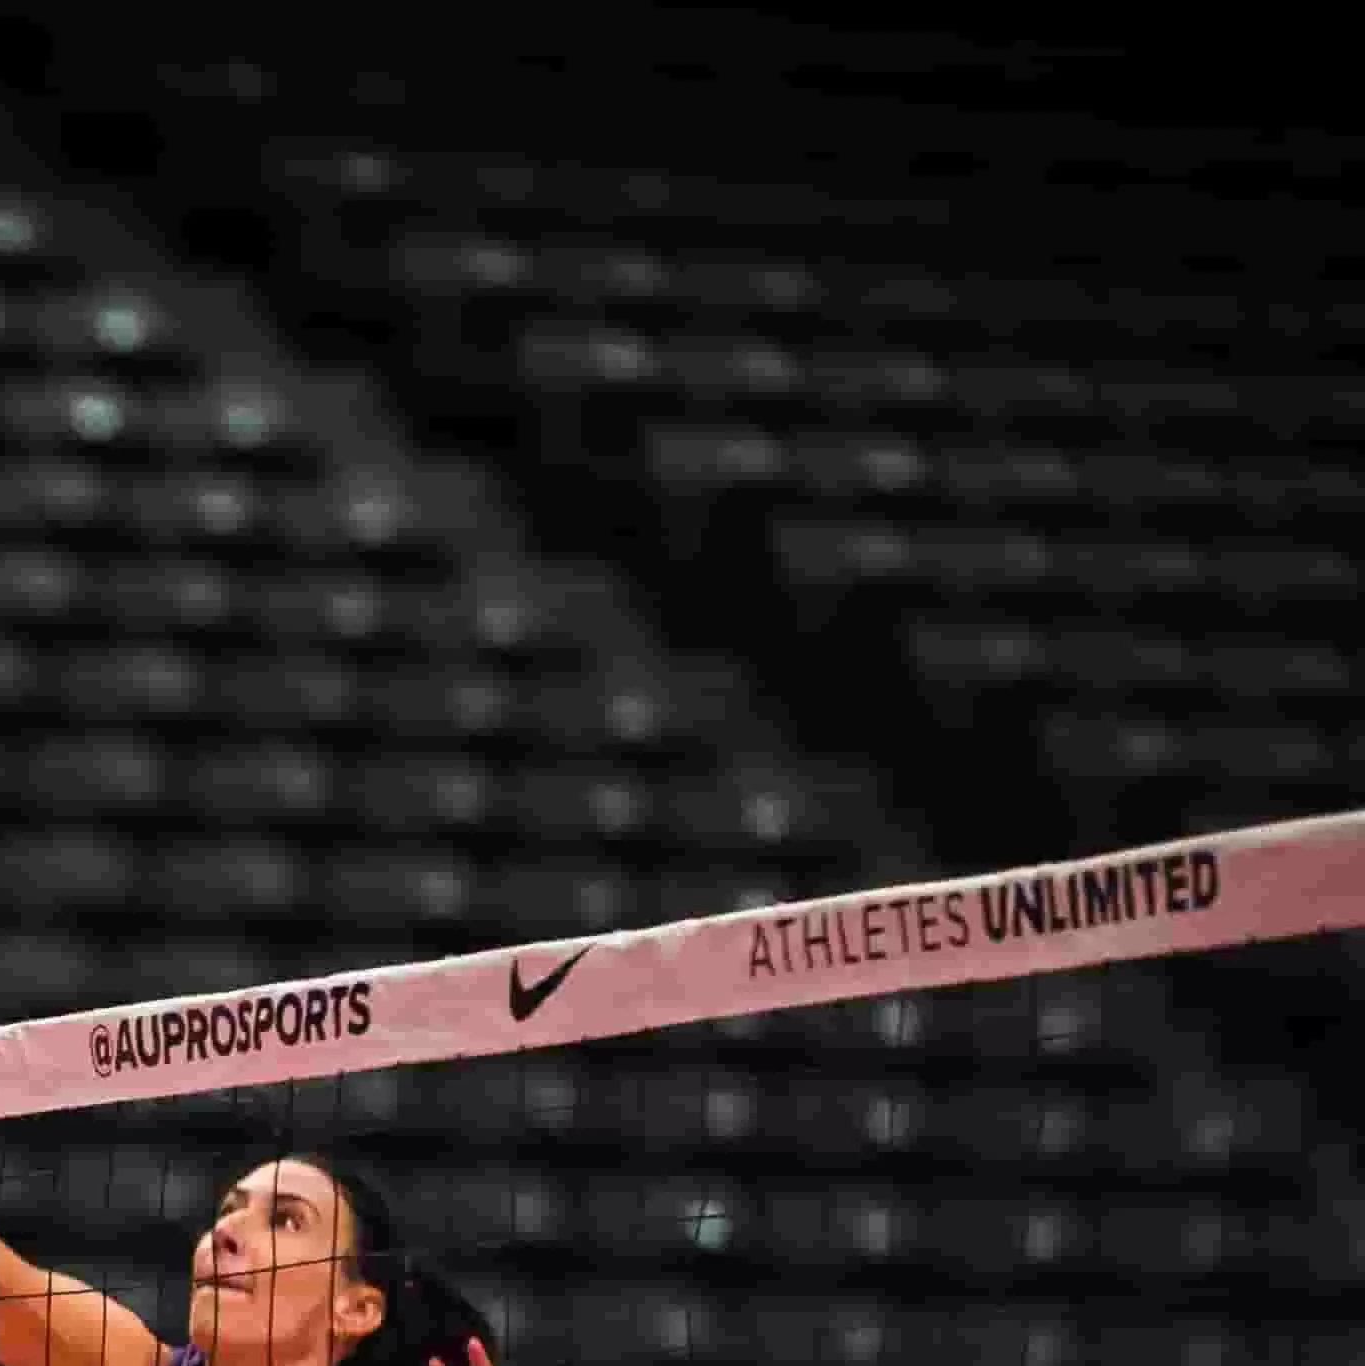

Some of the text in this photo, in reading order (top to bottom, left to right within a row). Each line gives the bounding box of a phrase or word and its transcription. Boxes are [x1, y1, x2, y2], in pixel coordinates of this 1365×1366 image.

[749, 851, 1219, 978] ATHLETES UNLIMITED
[90, 982, 372, 1077] @AUPROSPORTS
